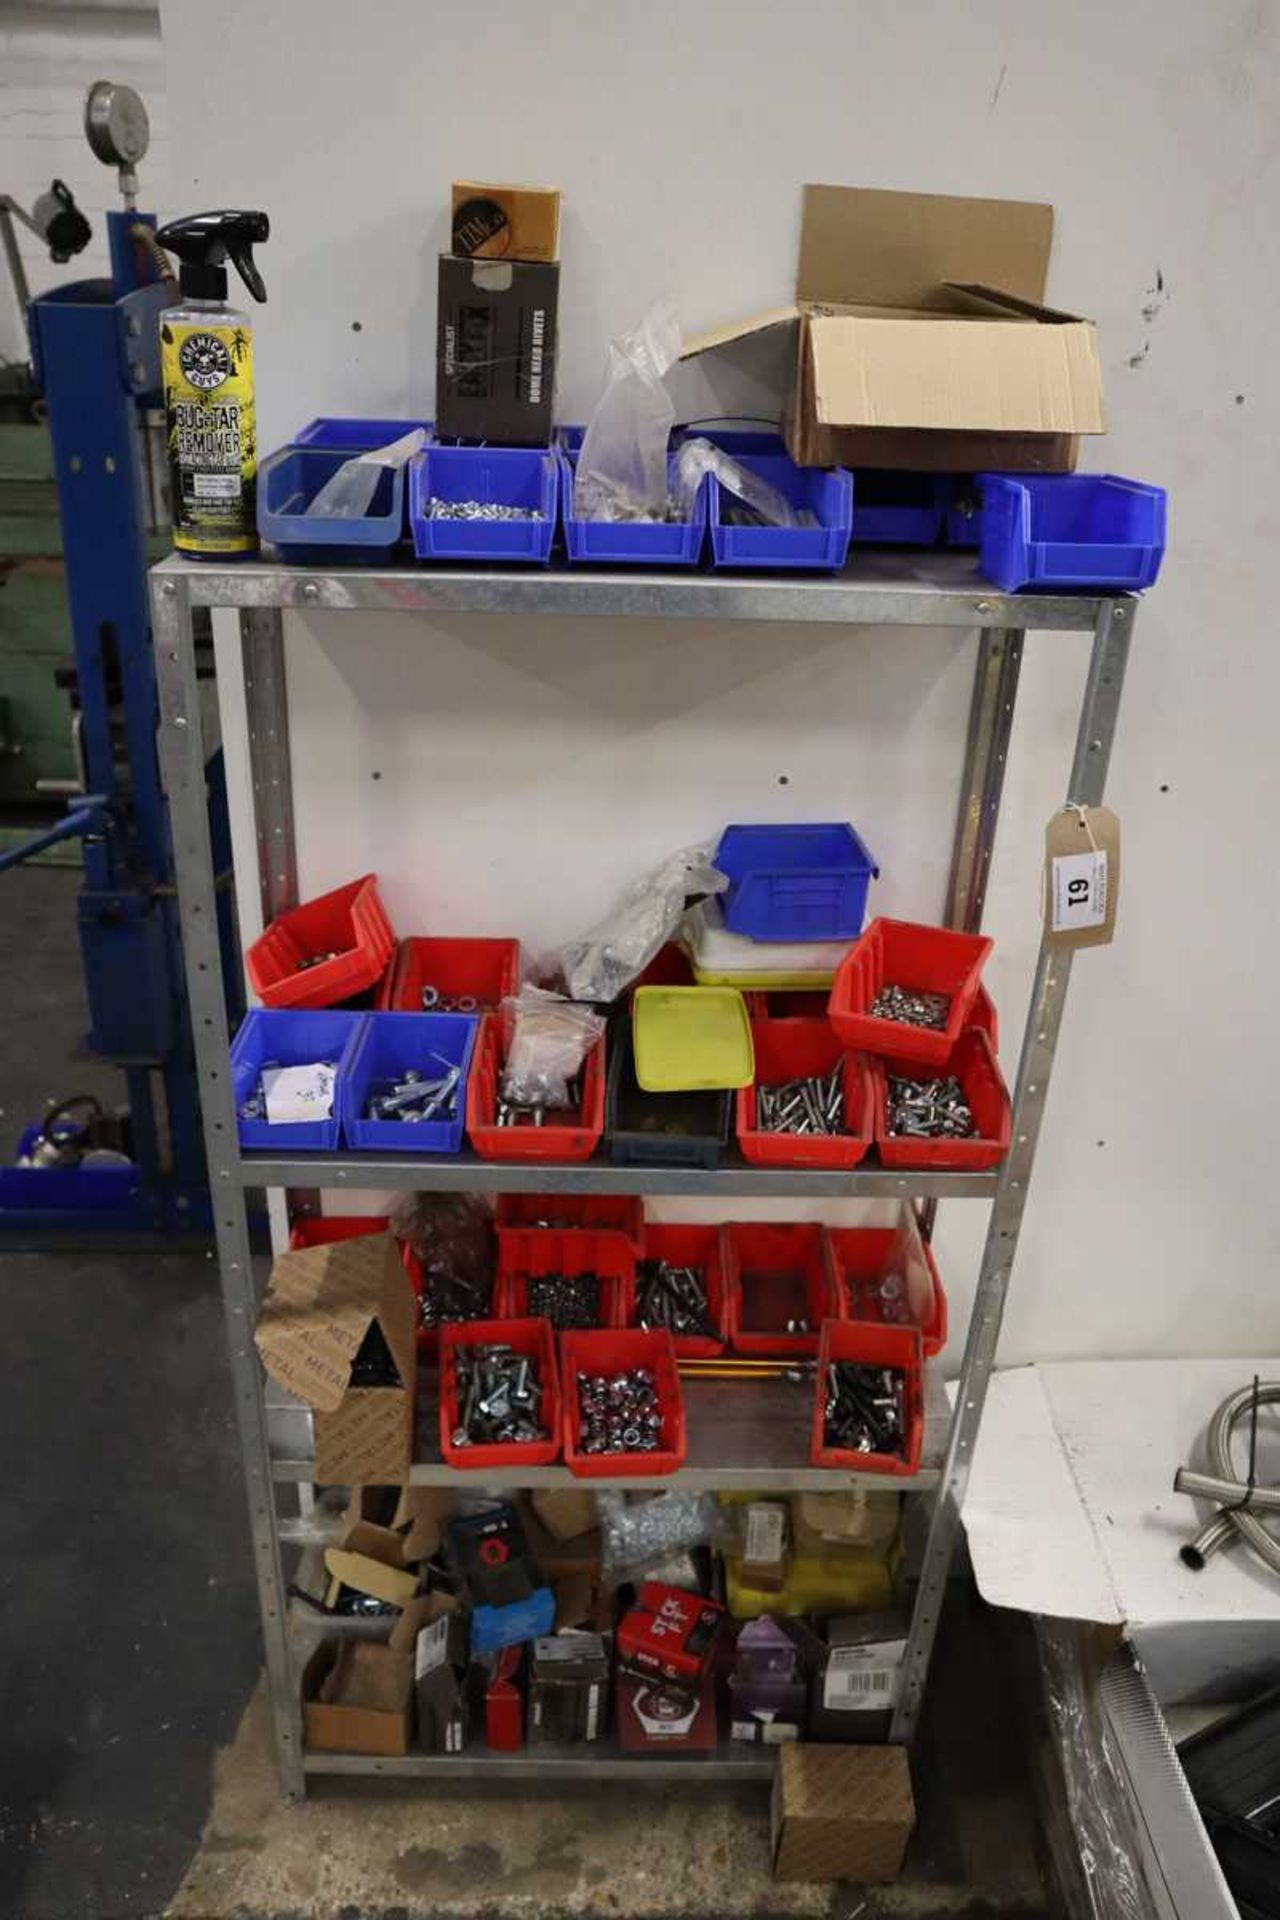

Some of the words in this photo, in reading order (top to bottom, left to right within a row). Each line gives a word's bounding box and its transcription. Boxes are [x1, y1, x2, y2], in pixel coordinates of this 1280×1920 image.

[533, 310, 545, 345] RIVETS
[182, 338, 228, 369] CHEMICAL
[531, 347, 543, 373] HEAD
[191, 374, 220, 386] GUYS
[529, 376, 541, 403] DOME
[179, 431, 240, 453] REMOVER
[1069, 880, 1088, 907] 61
